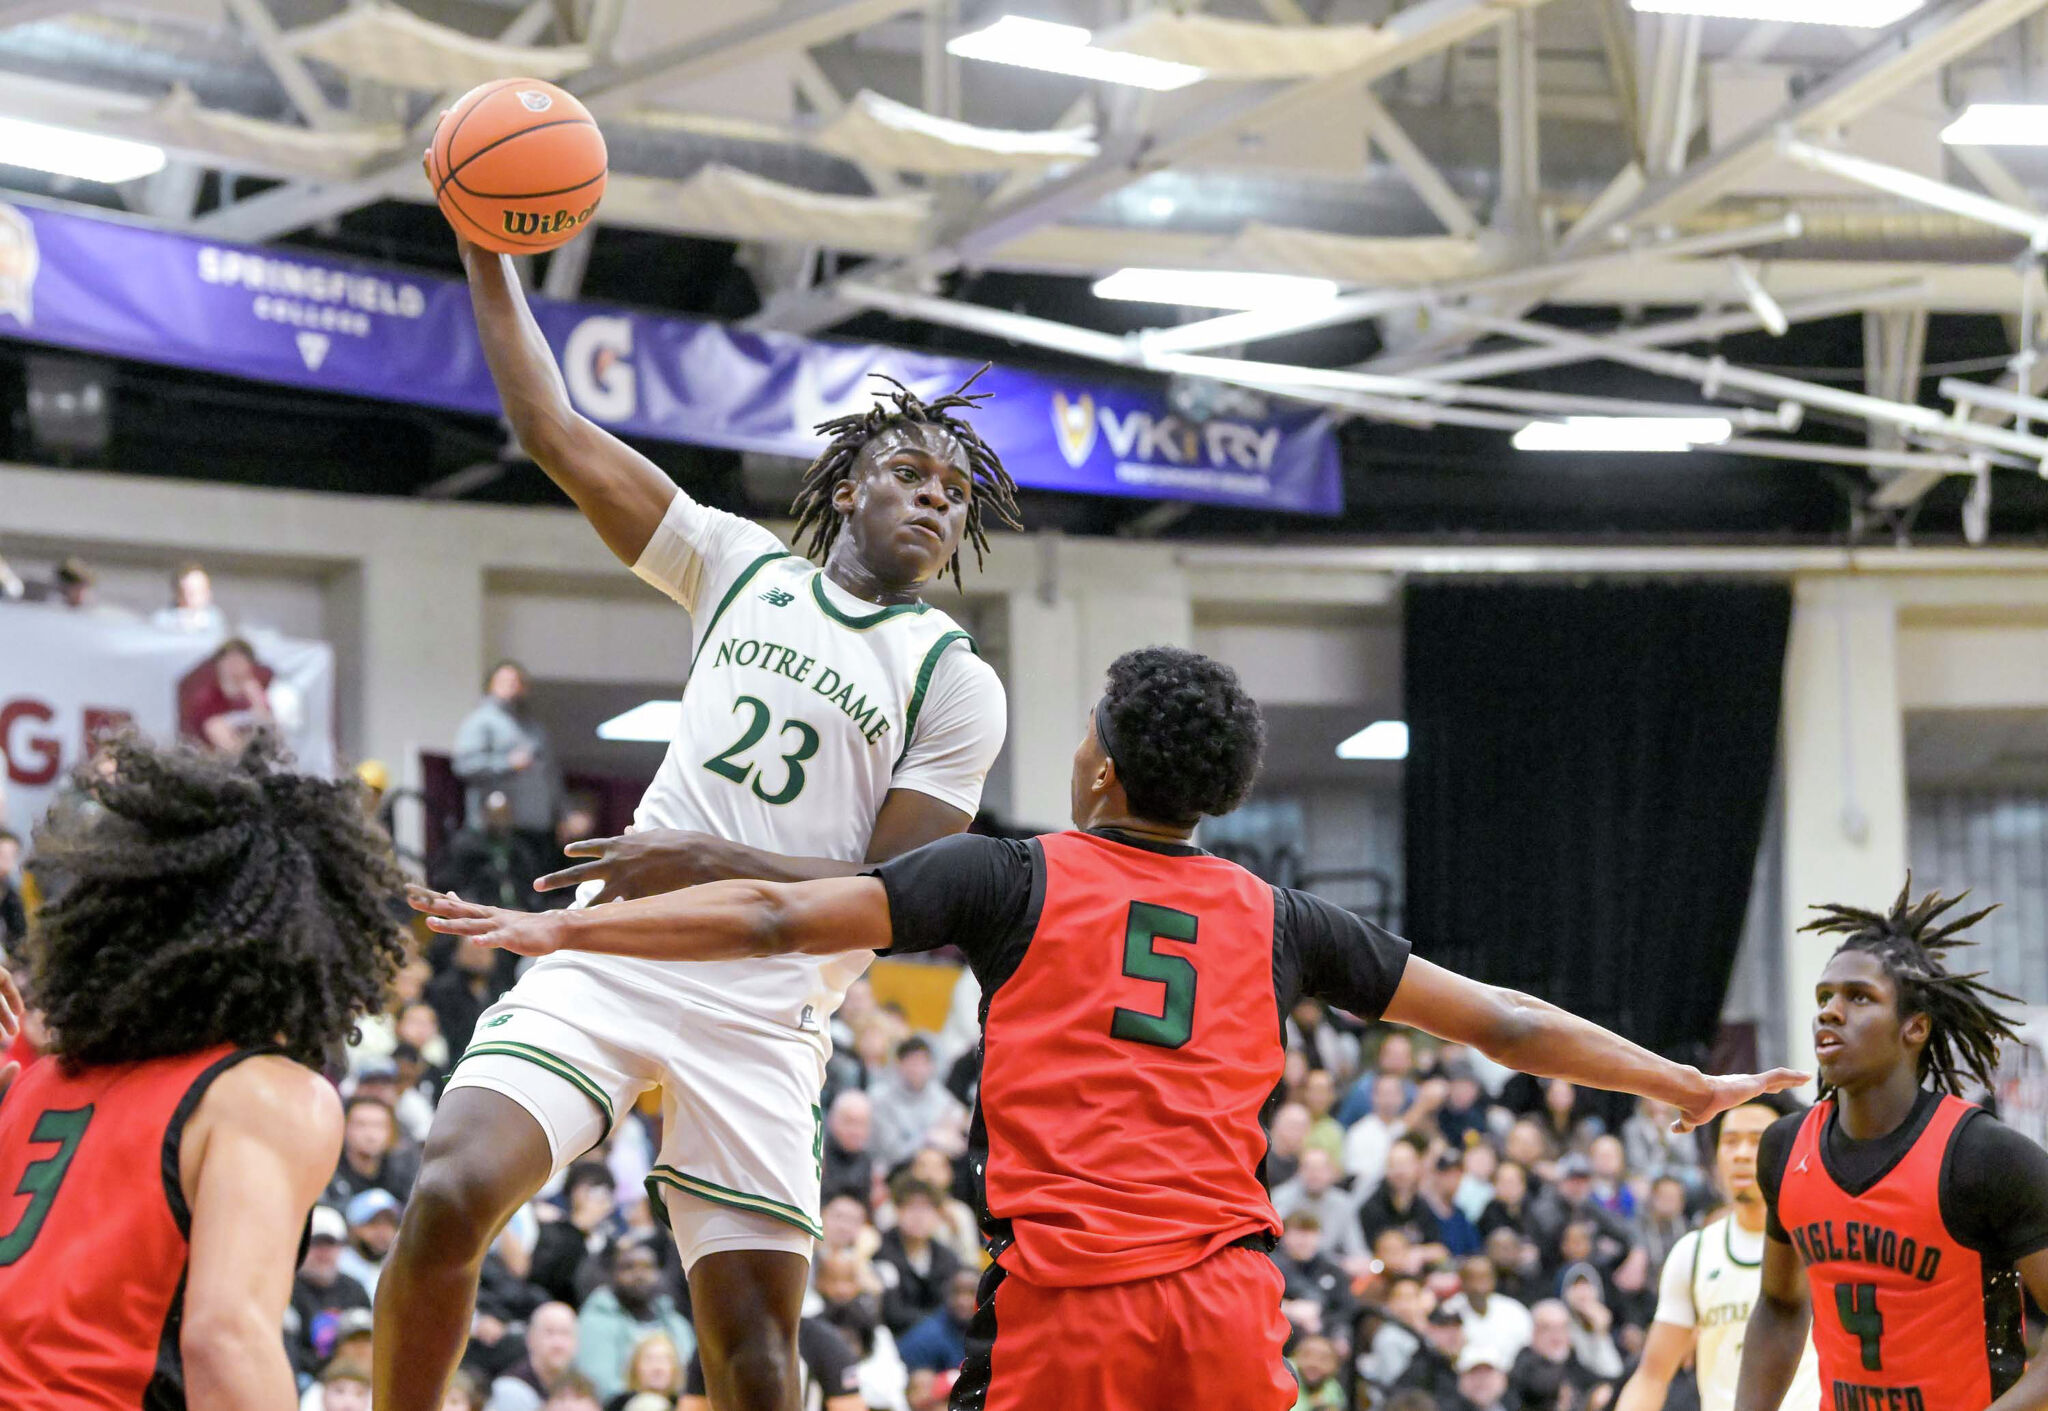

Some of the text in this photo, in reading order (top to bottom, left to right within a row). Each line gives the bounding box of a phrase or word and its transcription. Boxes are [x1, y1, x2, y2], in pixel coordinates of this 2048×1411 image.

[198, 245, 426, 319] SPRINGFIELD
[253, 295, 372, 338] COLLEGE
[563, 315, 636, 423] G
[713, 638, 892, 746] NOTRE DAME
[702, 695, 820, 805] 23
[1110, 899, 1199, 1050] 5
[0, 1102, 95, 1268] 3
[1792, 1220, 1942, 1282] NGLEWOOD
[1833, 1283, 1884, 1371] 4
